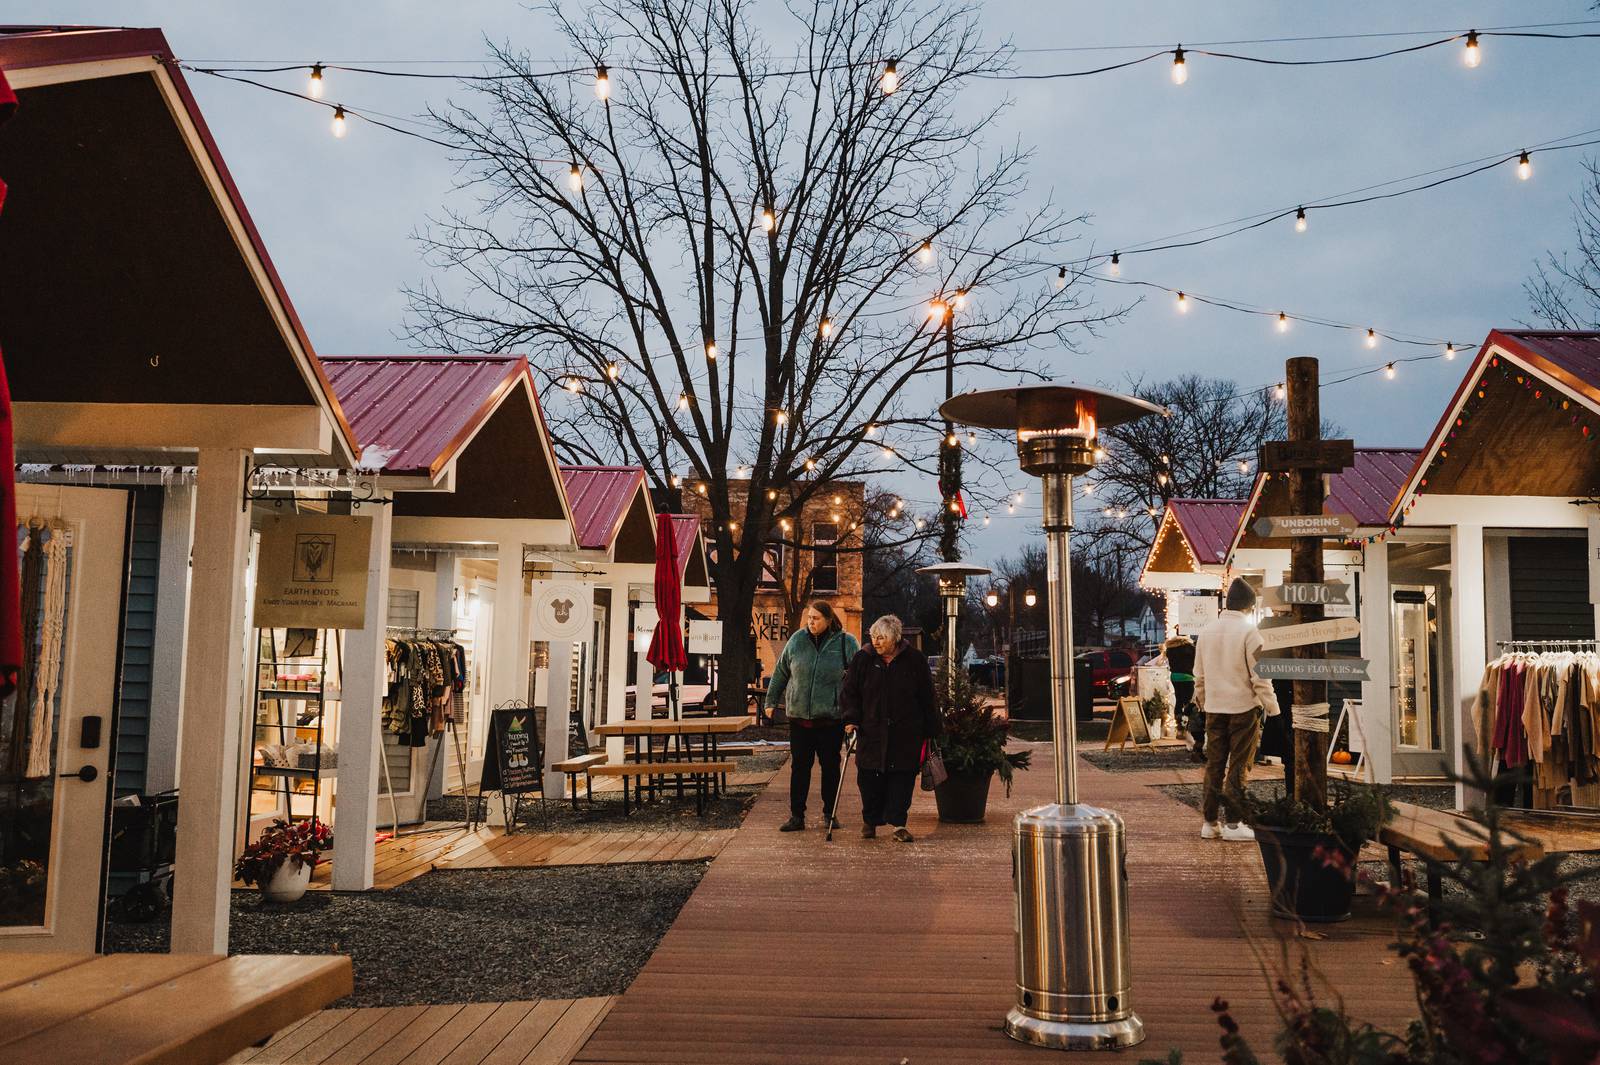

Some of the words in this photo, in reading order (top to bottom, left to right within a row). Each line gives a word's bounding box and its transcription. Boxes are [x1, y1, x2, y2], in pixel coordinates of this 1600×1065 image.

[1281, 518, 1340, 527] UNBORING
[312, 588, 339, 596] KNOTS
[1259, 664, 1305, 674] FARMDOG
[1307, 665, 1352, 674] FLOWERS
